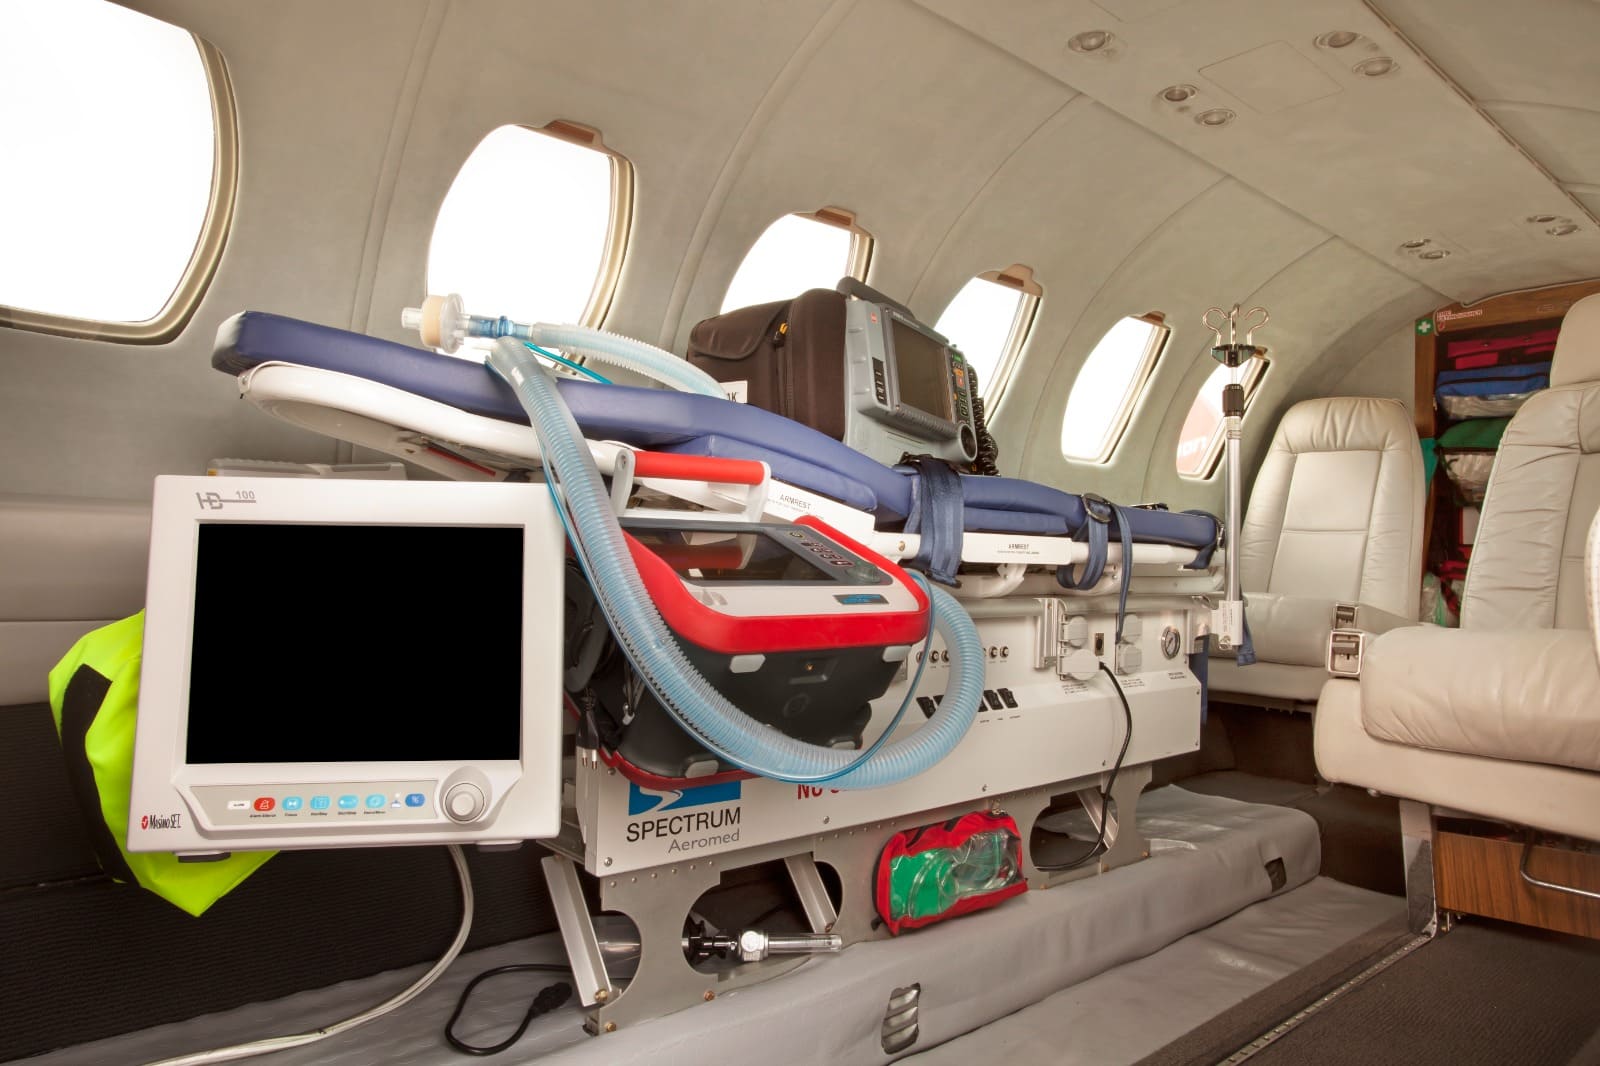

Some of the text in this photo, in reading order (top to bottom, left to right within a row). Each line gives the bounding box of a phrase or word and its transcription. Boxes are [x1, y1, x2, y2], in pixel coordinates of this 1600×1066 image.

[236, 490, 256, 499] 100
[780, 494, 811, 509] ARMREST
[626, 807, 741, 842] SPECTRUM
[668, 829, 740, 853] Aeromed
